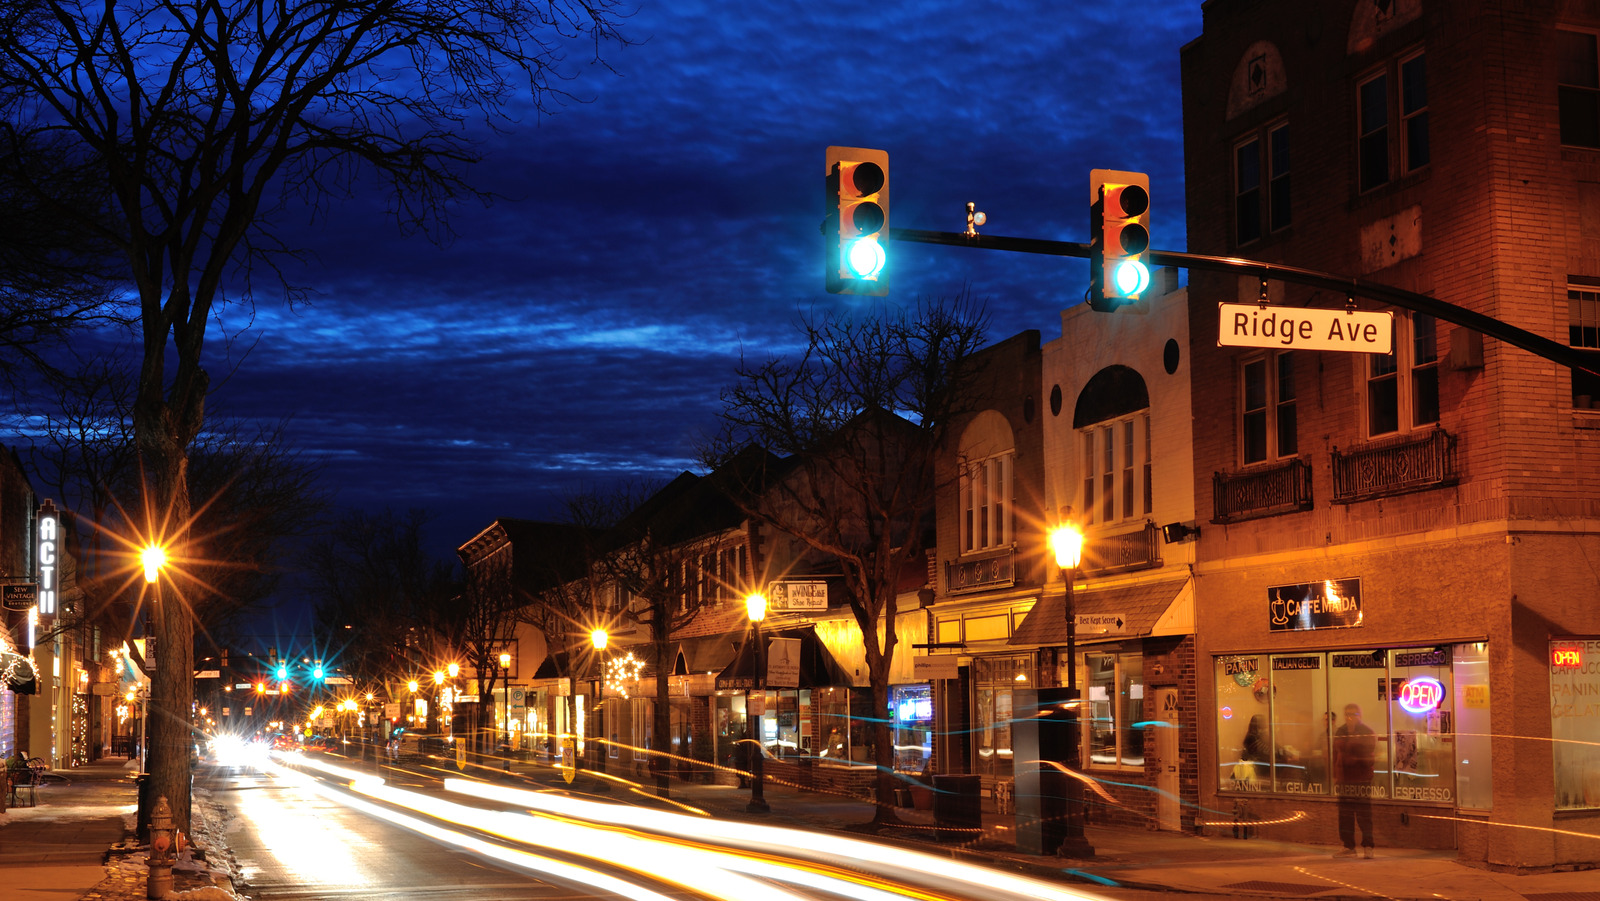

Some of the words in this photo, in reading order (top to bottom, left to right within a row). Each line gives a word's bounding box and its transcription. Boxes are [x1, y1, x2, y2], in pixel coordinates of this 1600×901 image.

[1233, 311, 1313, 344] Ridge
[1327, 318, 1377, 343] Ave
[41, 517, 55, 589] ACT
[1286, 595, 1320, 616] CAFFÉ
[1321, 596, 1357, 614] MAIDA
[1080, 616, 1089, 624] Best
[1090, 616, 1101, 625] Kept
[1102, 616, 1116, 625] Secret
[1272, 657, 1297, 669] ITALIAN
[1298, 656, 1320, 669] GELATI
[1396, 653, 1446, 667] ESPRESSO
[1554, 651, 1580, 665] OPEN
[1226, 659, 1258, 675] PANINI
[1401, 684, 1440, 708] OPEN
[1230, 780, 1261, 792] PANINI
[1286, 782, 1323, 794] GELATI
[1333, 784, 1386, 798] CAPPUCCINO
[1395, 787, 1451, 800] ESPRESSO
